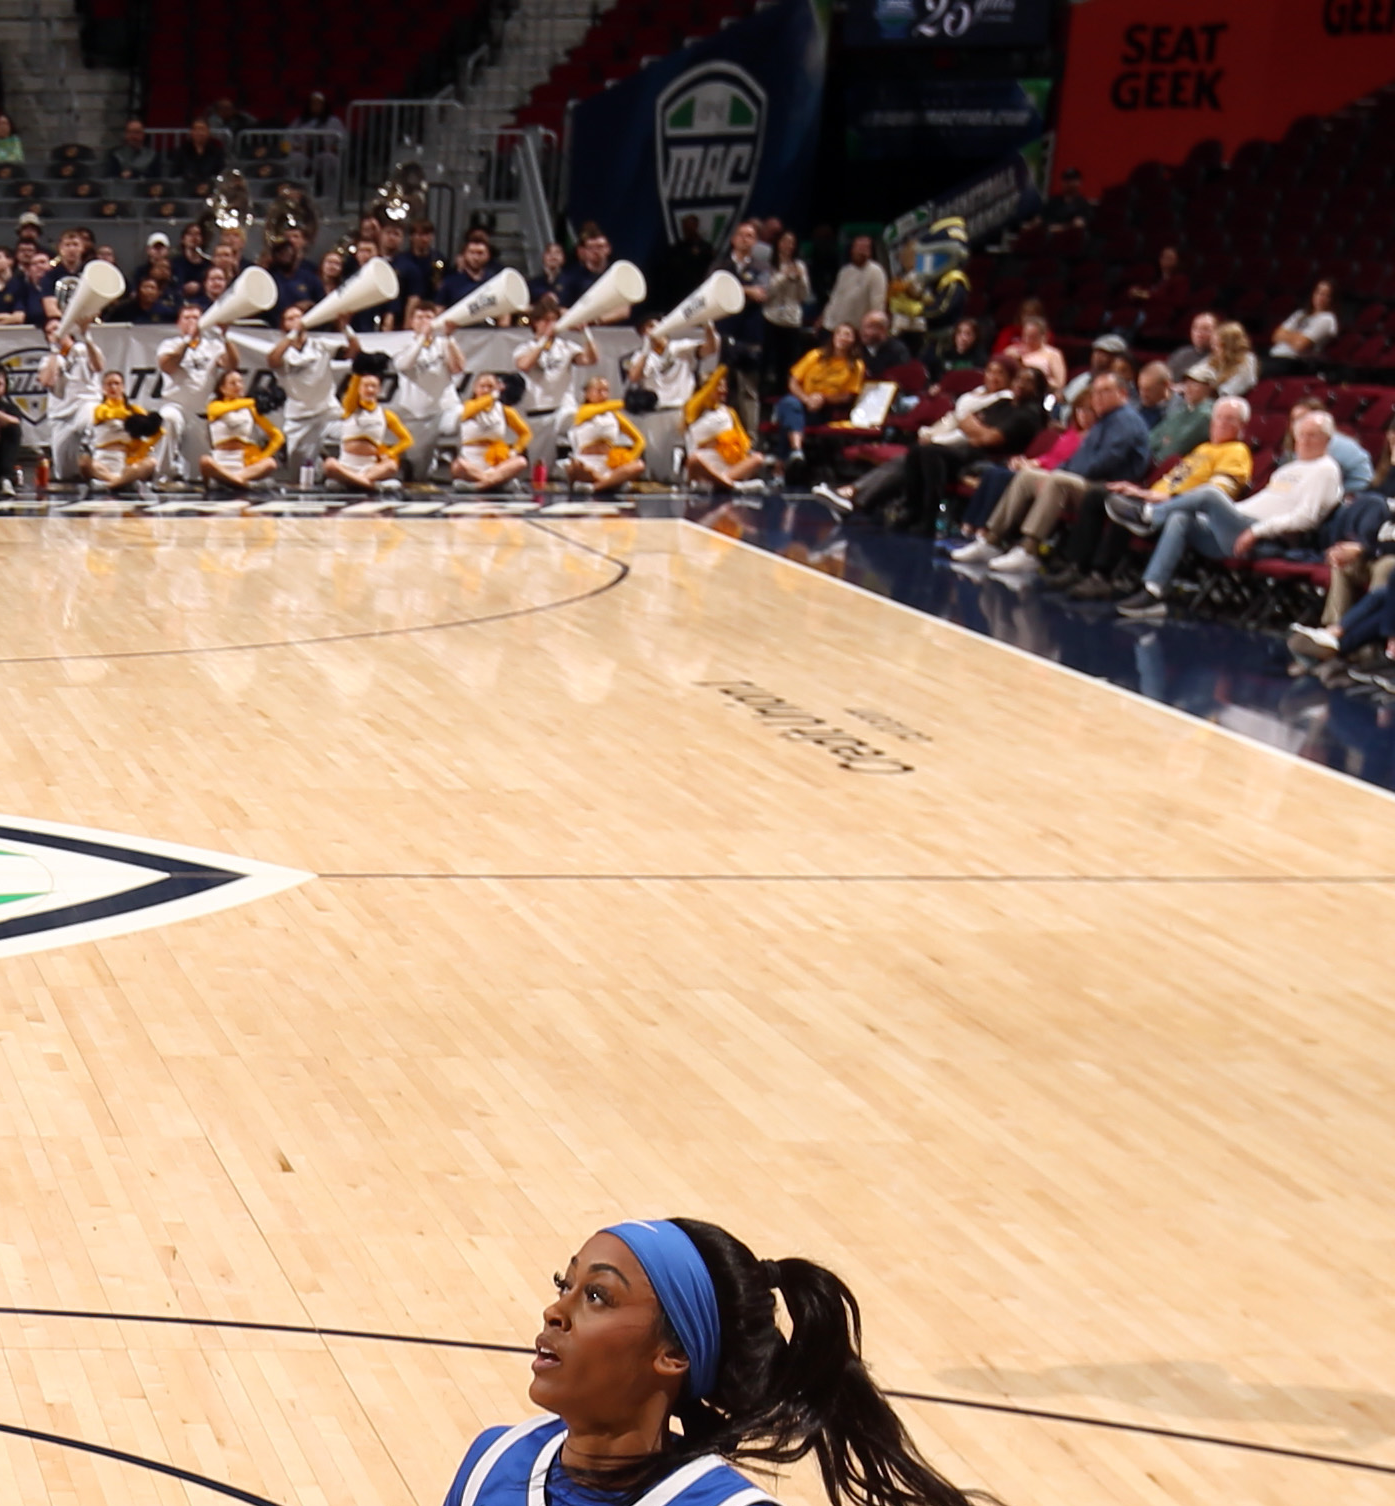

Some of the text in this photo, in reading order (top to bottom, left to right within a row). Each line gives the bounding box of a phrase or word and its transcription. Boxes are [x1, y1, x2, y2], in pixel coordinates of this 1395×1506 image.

[1323, 0, 1395, 35] GEE
[1121, 23, 1228, 65] SEAT
[1110, 69, 1225, 112] GEEK
[663, 141, 753, 200] MAC
